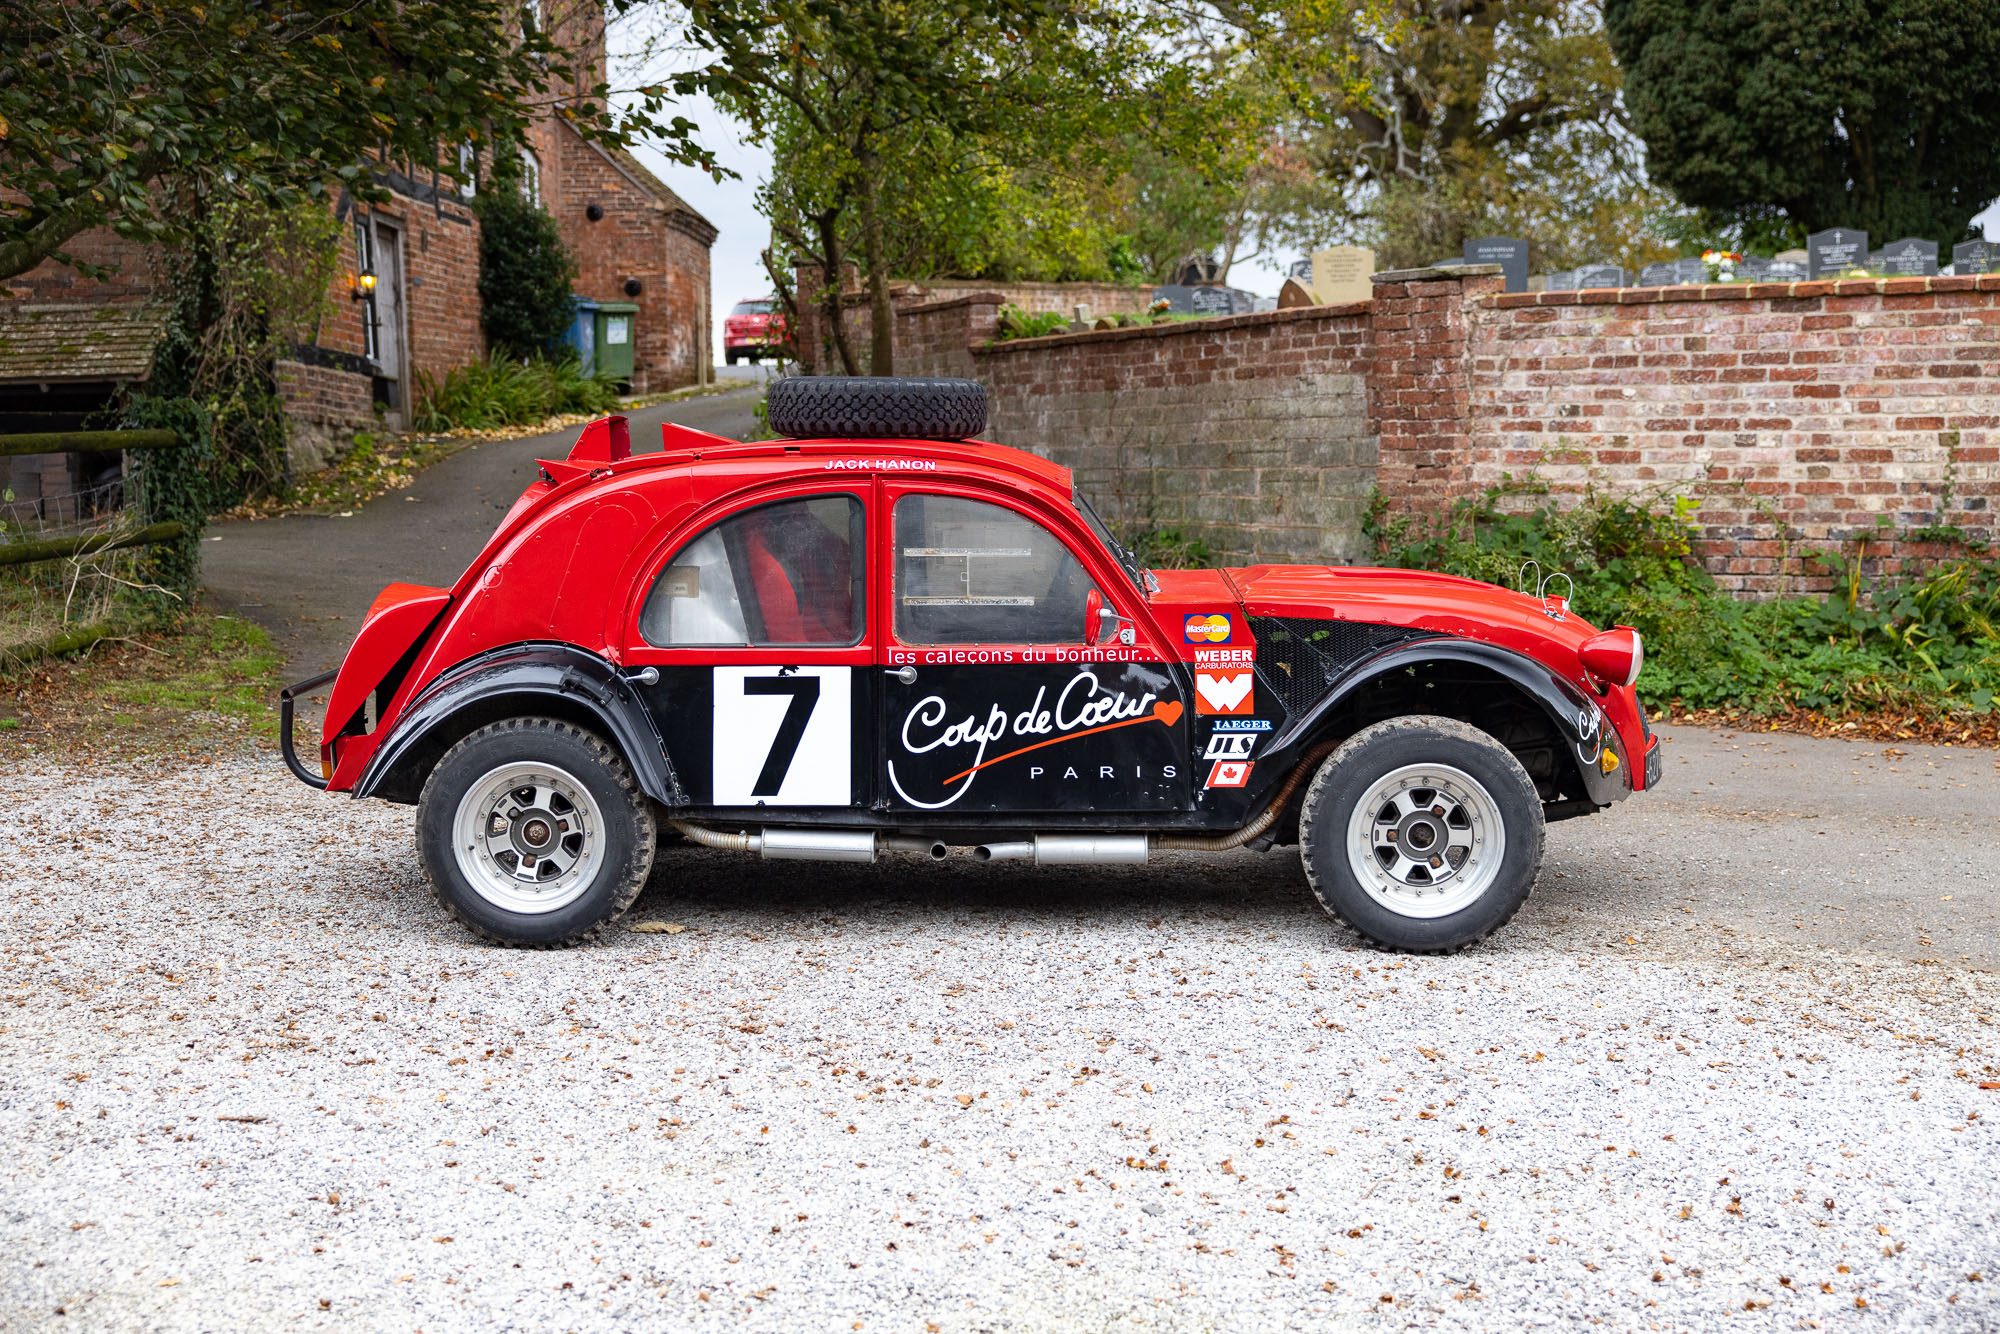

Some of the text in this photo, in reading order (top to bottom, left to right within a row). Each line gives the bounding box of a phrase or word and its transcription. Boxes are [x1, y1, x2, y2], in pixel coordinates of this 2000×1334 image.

[824, 459, 936, 471] JACK HANON
[1185, 624, 1230, 633] MasterCard
[887, 647, 1158, 665] les caleçons du bonheur...
[1194, 650, 1253, 662] WEBER
[1194, 661, 1253, 670] CARBURATORS
[1212, 720, 1273, 731] JAEGER
[743, 675, 820, 797] 7
[887, 695, 1008, 809] Coup
[1012, 685, 1053, 735] de
[1030, 764, 1177, 780] PARIS
